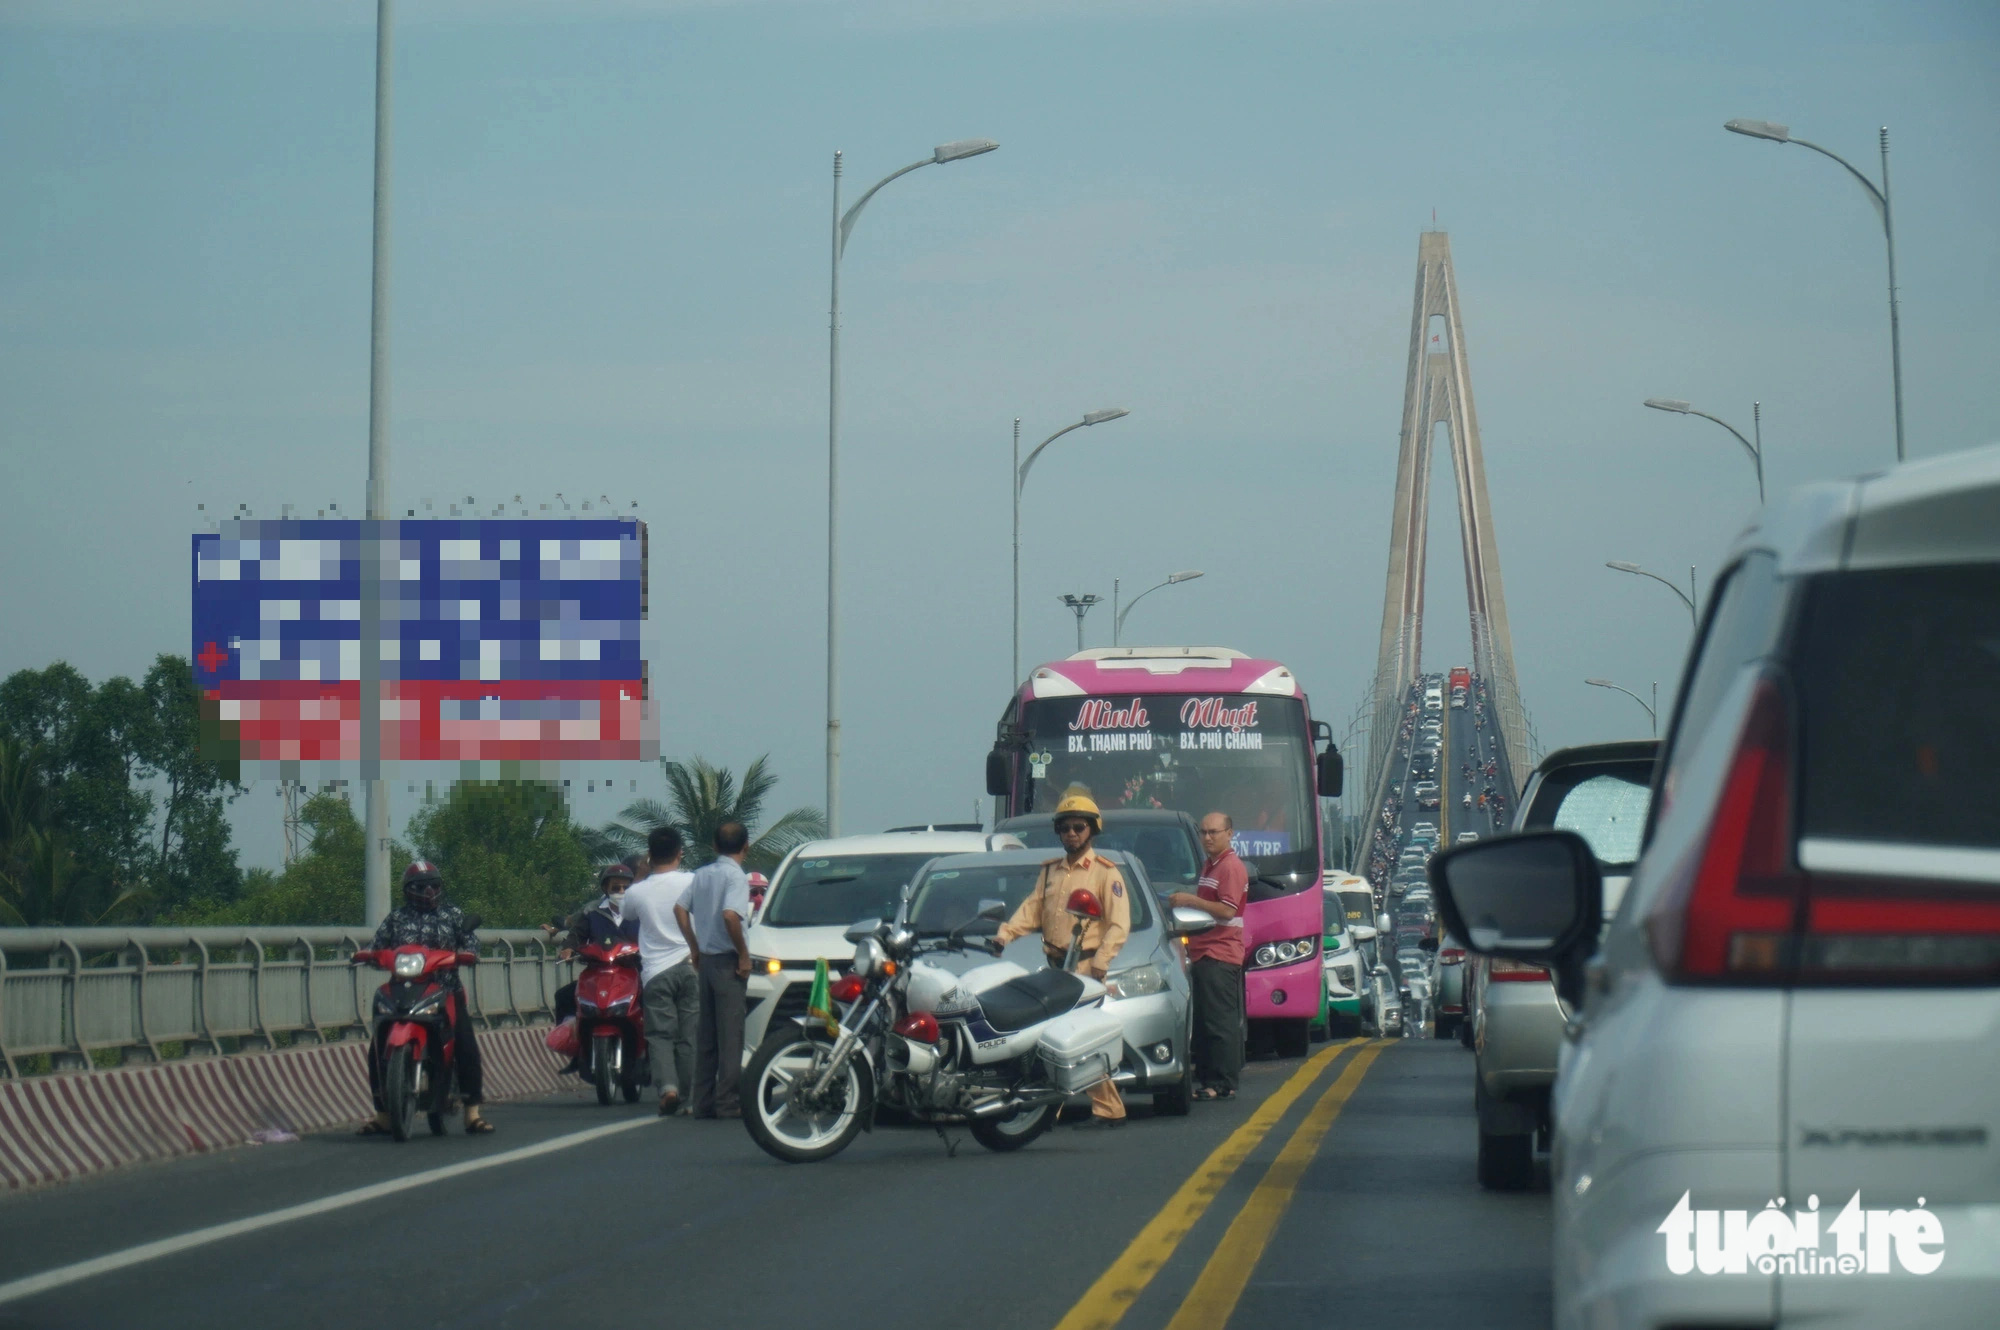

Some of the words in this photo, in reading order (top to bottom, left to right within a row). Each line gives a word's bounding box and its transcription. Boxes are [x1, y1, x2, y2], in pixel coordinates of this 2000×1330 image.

[1068, 697, 1150, 731] Minh
[1180, 697, 1259, 733] Nhựt
[1068, 735, 1087, 753] BX.
[1089, 734, 1127, 754] THẠNH
[1129, 729, 1152, 751] PHÚ
[1180, 732, 1198, 750] BX.
[1200, 728, 1222, 750] PHÚ
[1224, 728, 1262, 750] CHÁNH
[1230, 832, 1250, 857] ẾN
[1253, 840, 1282, 857] TRE
[978, 1037, 1007, 1050] POLICE
